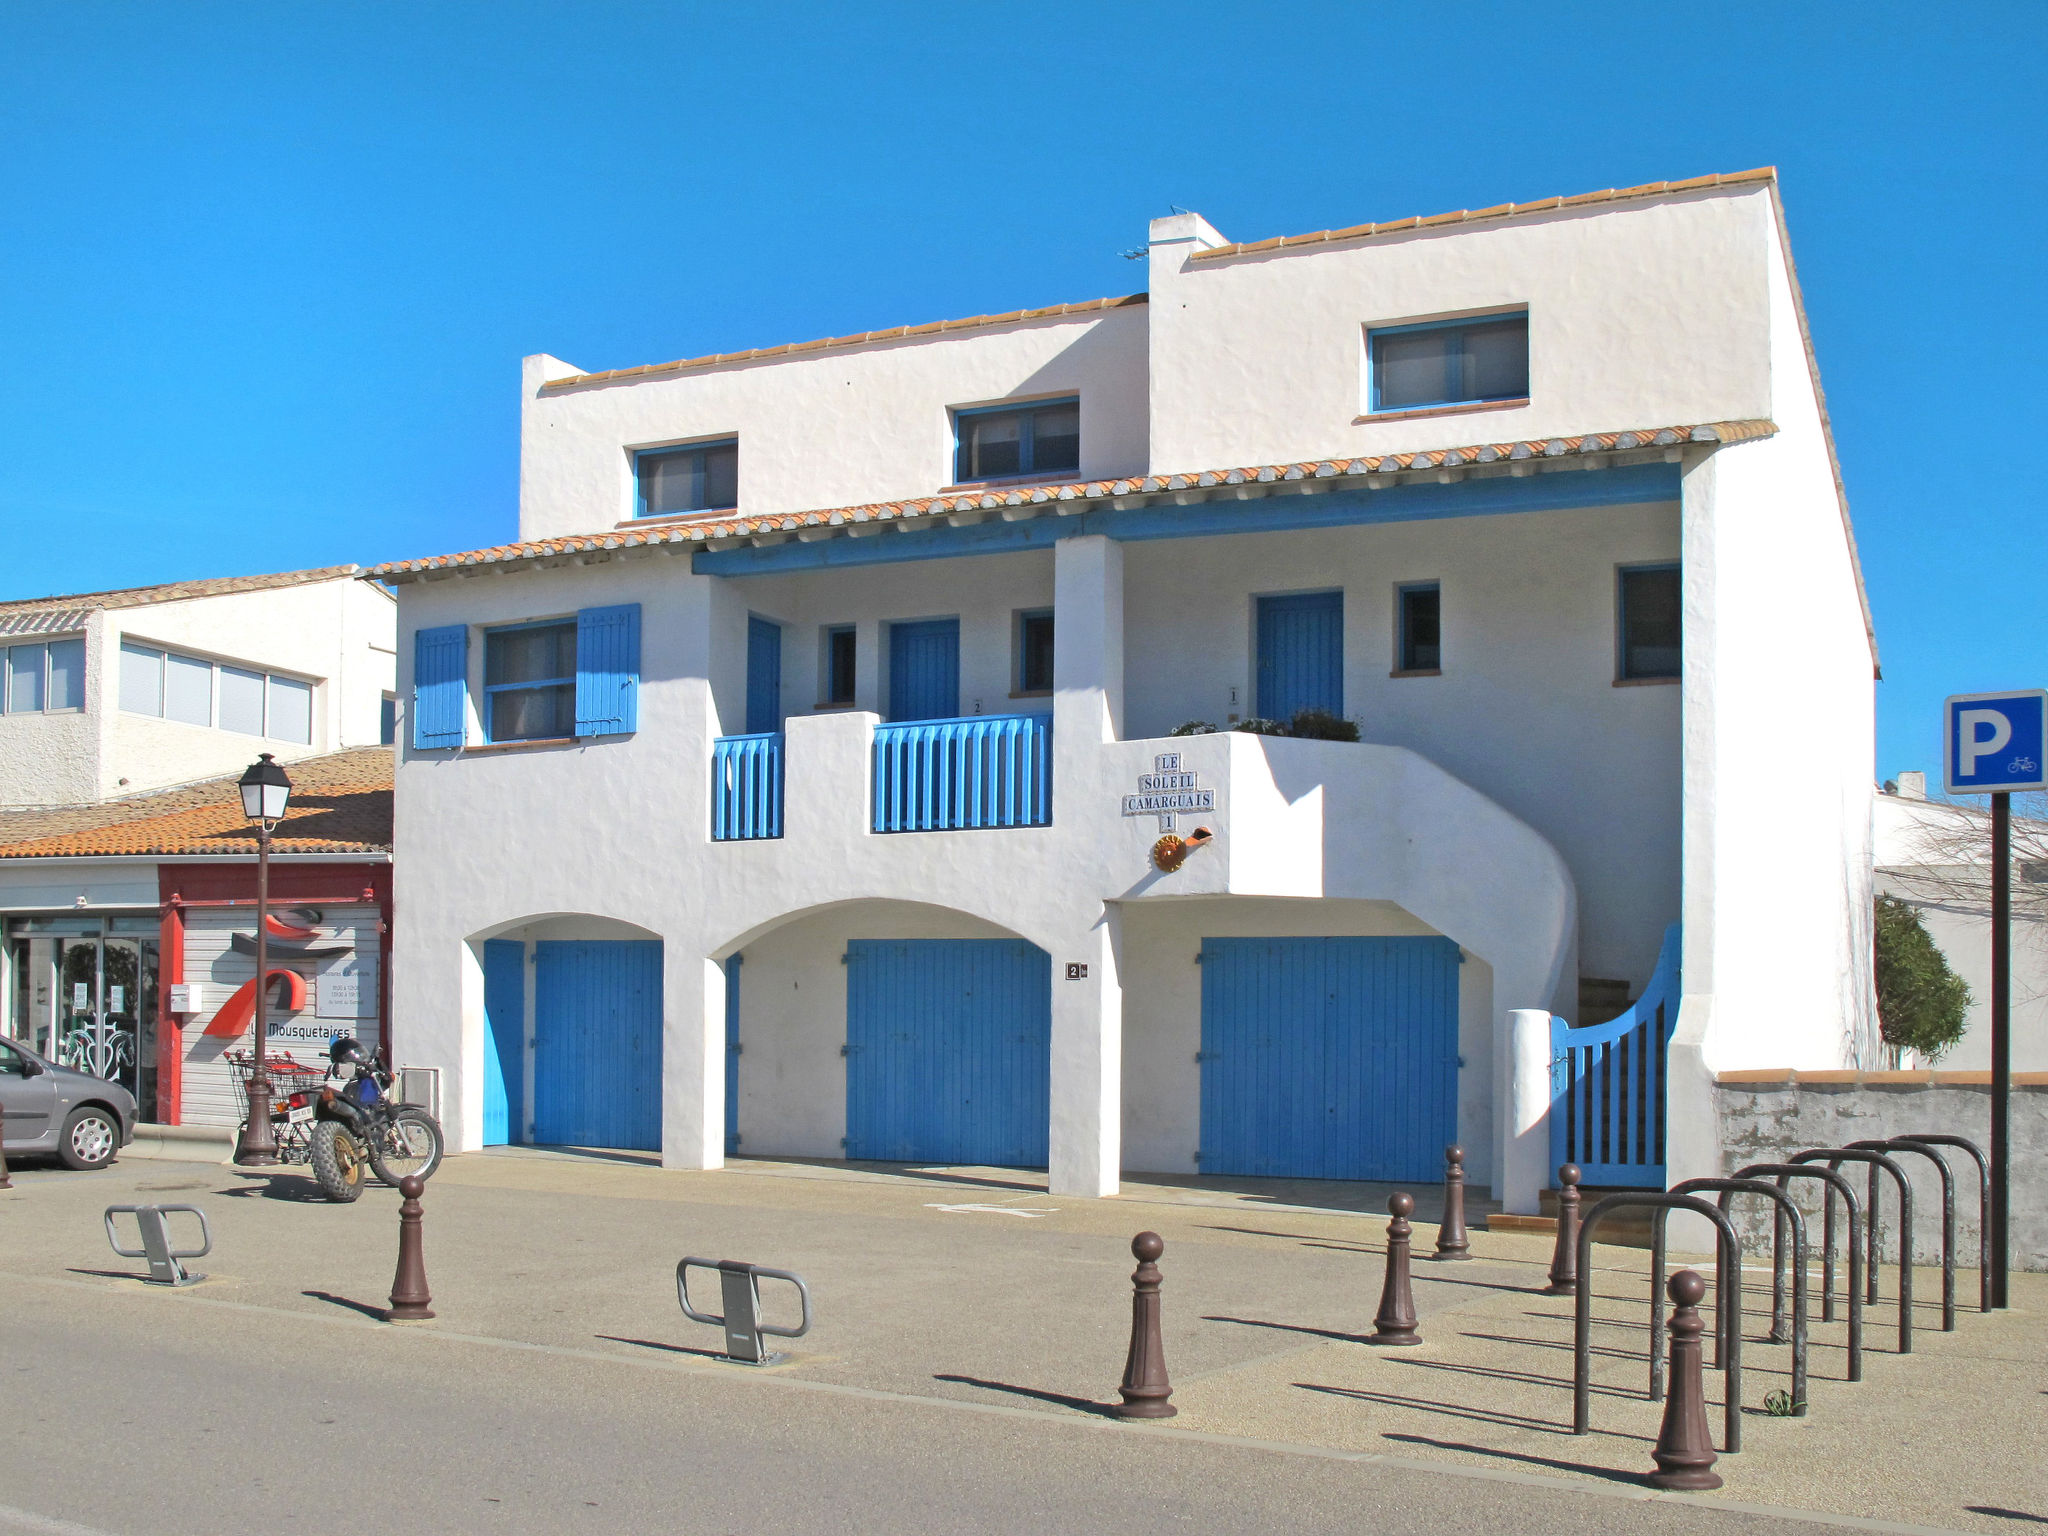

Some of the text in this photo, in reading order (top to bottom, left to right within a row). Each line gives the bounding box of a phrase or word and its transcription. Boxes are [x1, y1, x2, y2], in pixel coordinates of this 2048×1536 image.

[1959, 708, 2012, 776] P
[1162, 756, 1178, 769] LE
[1144, 775, 1194, 790] SOLEIL
[1128, 793, 1210, 810] CAMARGUAIS
[1070, 966, 1077, 976] 2
[268, 1022, 350, 1041] Mousquetaires
